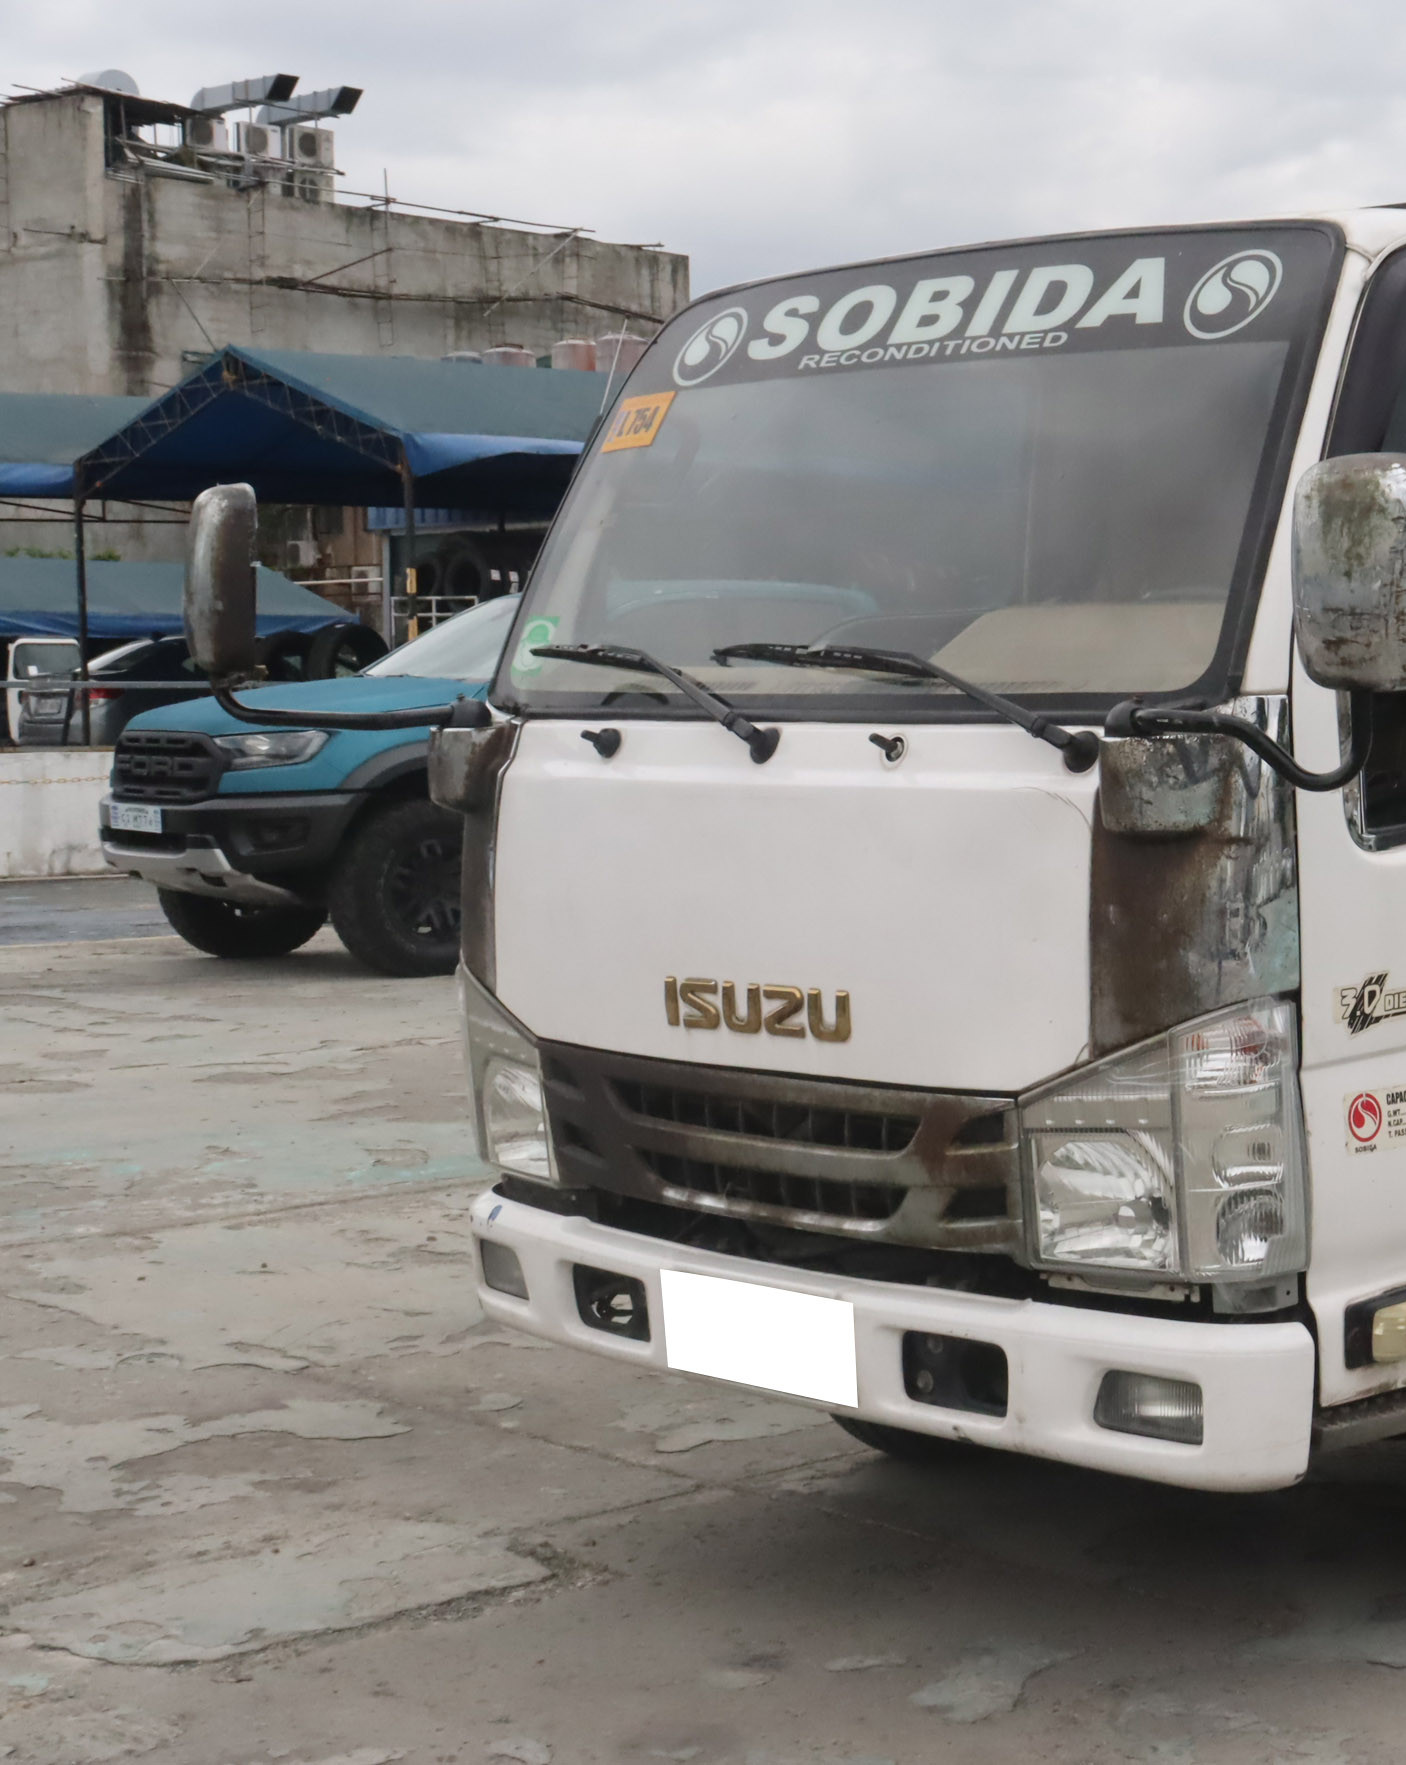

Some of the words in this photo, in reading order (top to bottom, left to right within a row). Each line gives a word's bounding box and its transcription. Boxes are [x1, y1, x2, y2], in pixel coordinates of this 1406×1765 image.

[747, 257, 1166, 360] SOBIDA
[798, 331, 1069, 370] RECONDITIONED
[664, 976, 851, 1042] ISUZU
